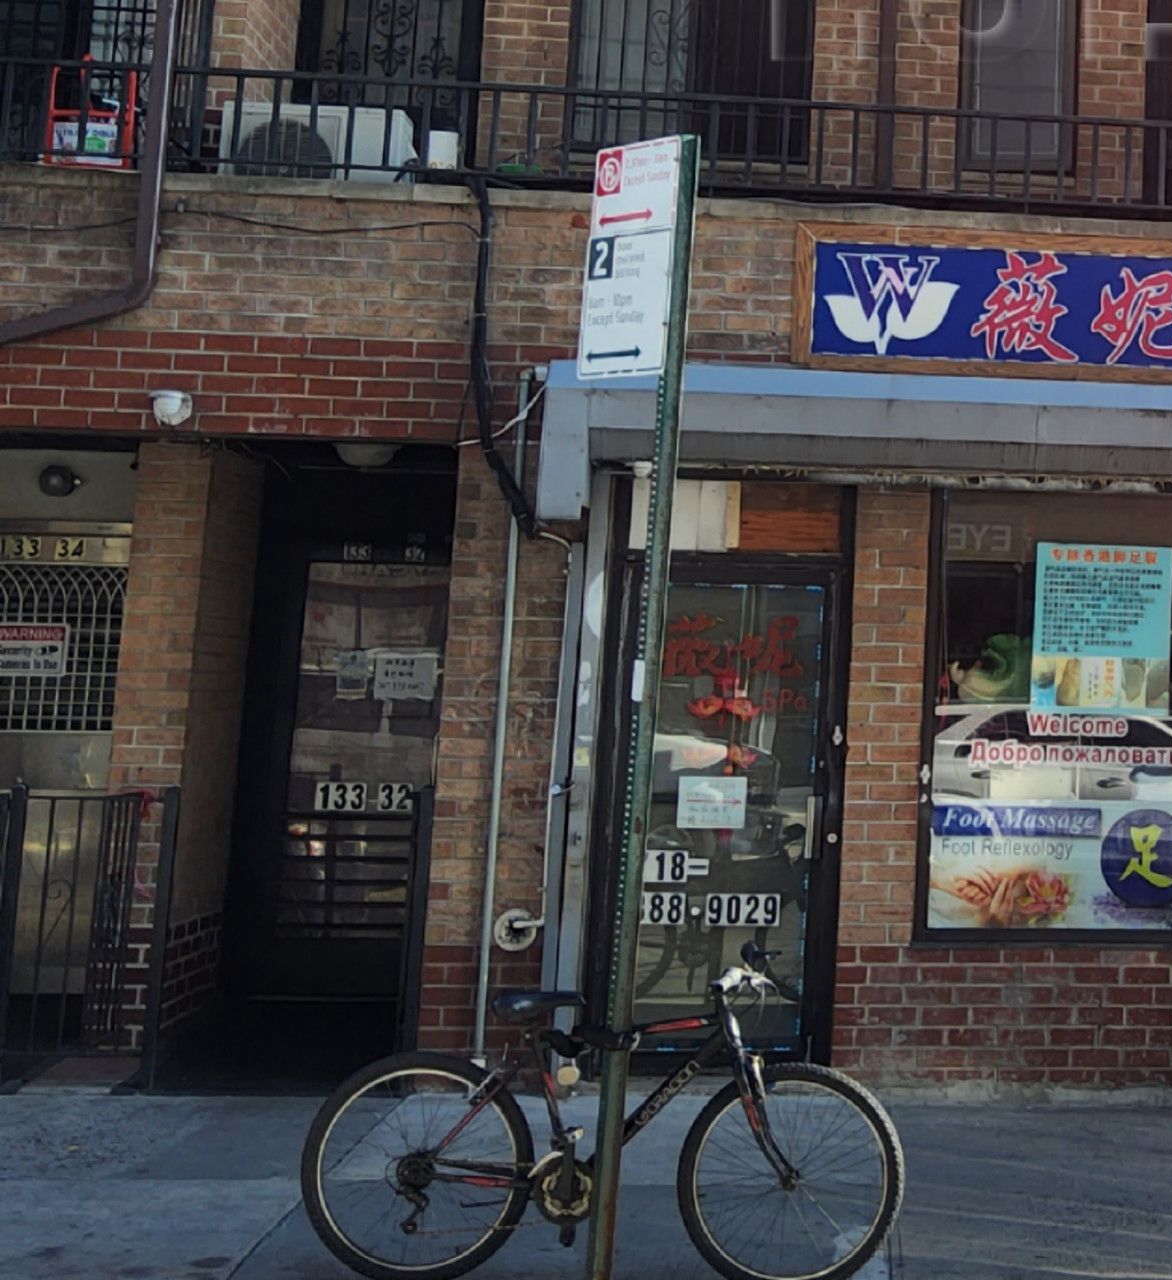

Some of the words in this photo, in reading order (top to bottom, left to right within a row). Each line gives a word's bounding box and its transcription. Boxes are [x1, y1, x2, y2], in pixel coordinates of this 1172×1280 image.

[593, 240, 609, 277] 2
[58, 538, 84, 558] 34
[1030, 714, 1127, 735] Welcome
[971, 741, 1042, 764] Добро
[320, 784, 364, 809] 133
[381, 784, 410, 809] 32
[942, 808, 995, 828] Foot
[1000, 809, 1096, 830] Massage
[941, 837, 976, 855] Foot
[981, 838, 1074, 859] Reflexology
